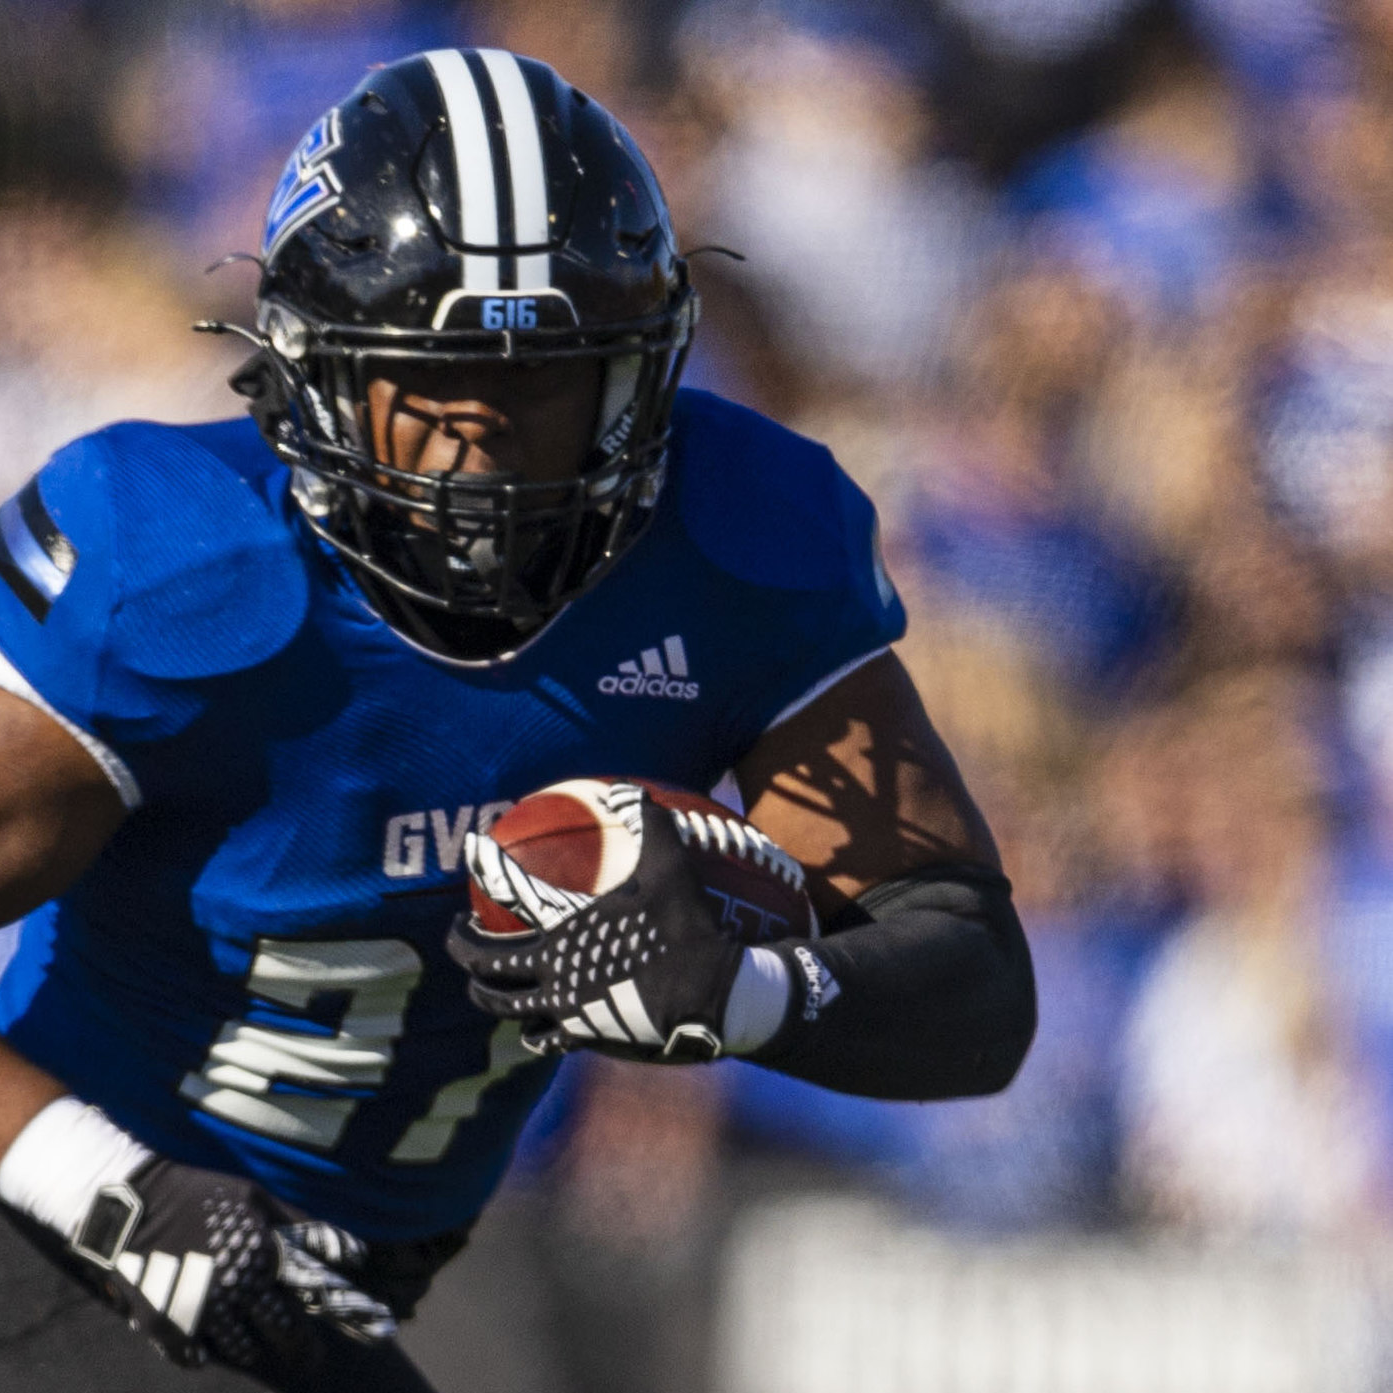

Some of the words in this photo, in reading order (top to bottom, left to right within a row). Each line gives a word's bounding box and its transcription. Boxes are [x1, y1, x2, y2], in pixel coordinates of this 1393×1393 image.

[481, 297, 538, 331] 616
[598, 671, 699, 700] adidas
[795, 946, 823, 1021] adidas
